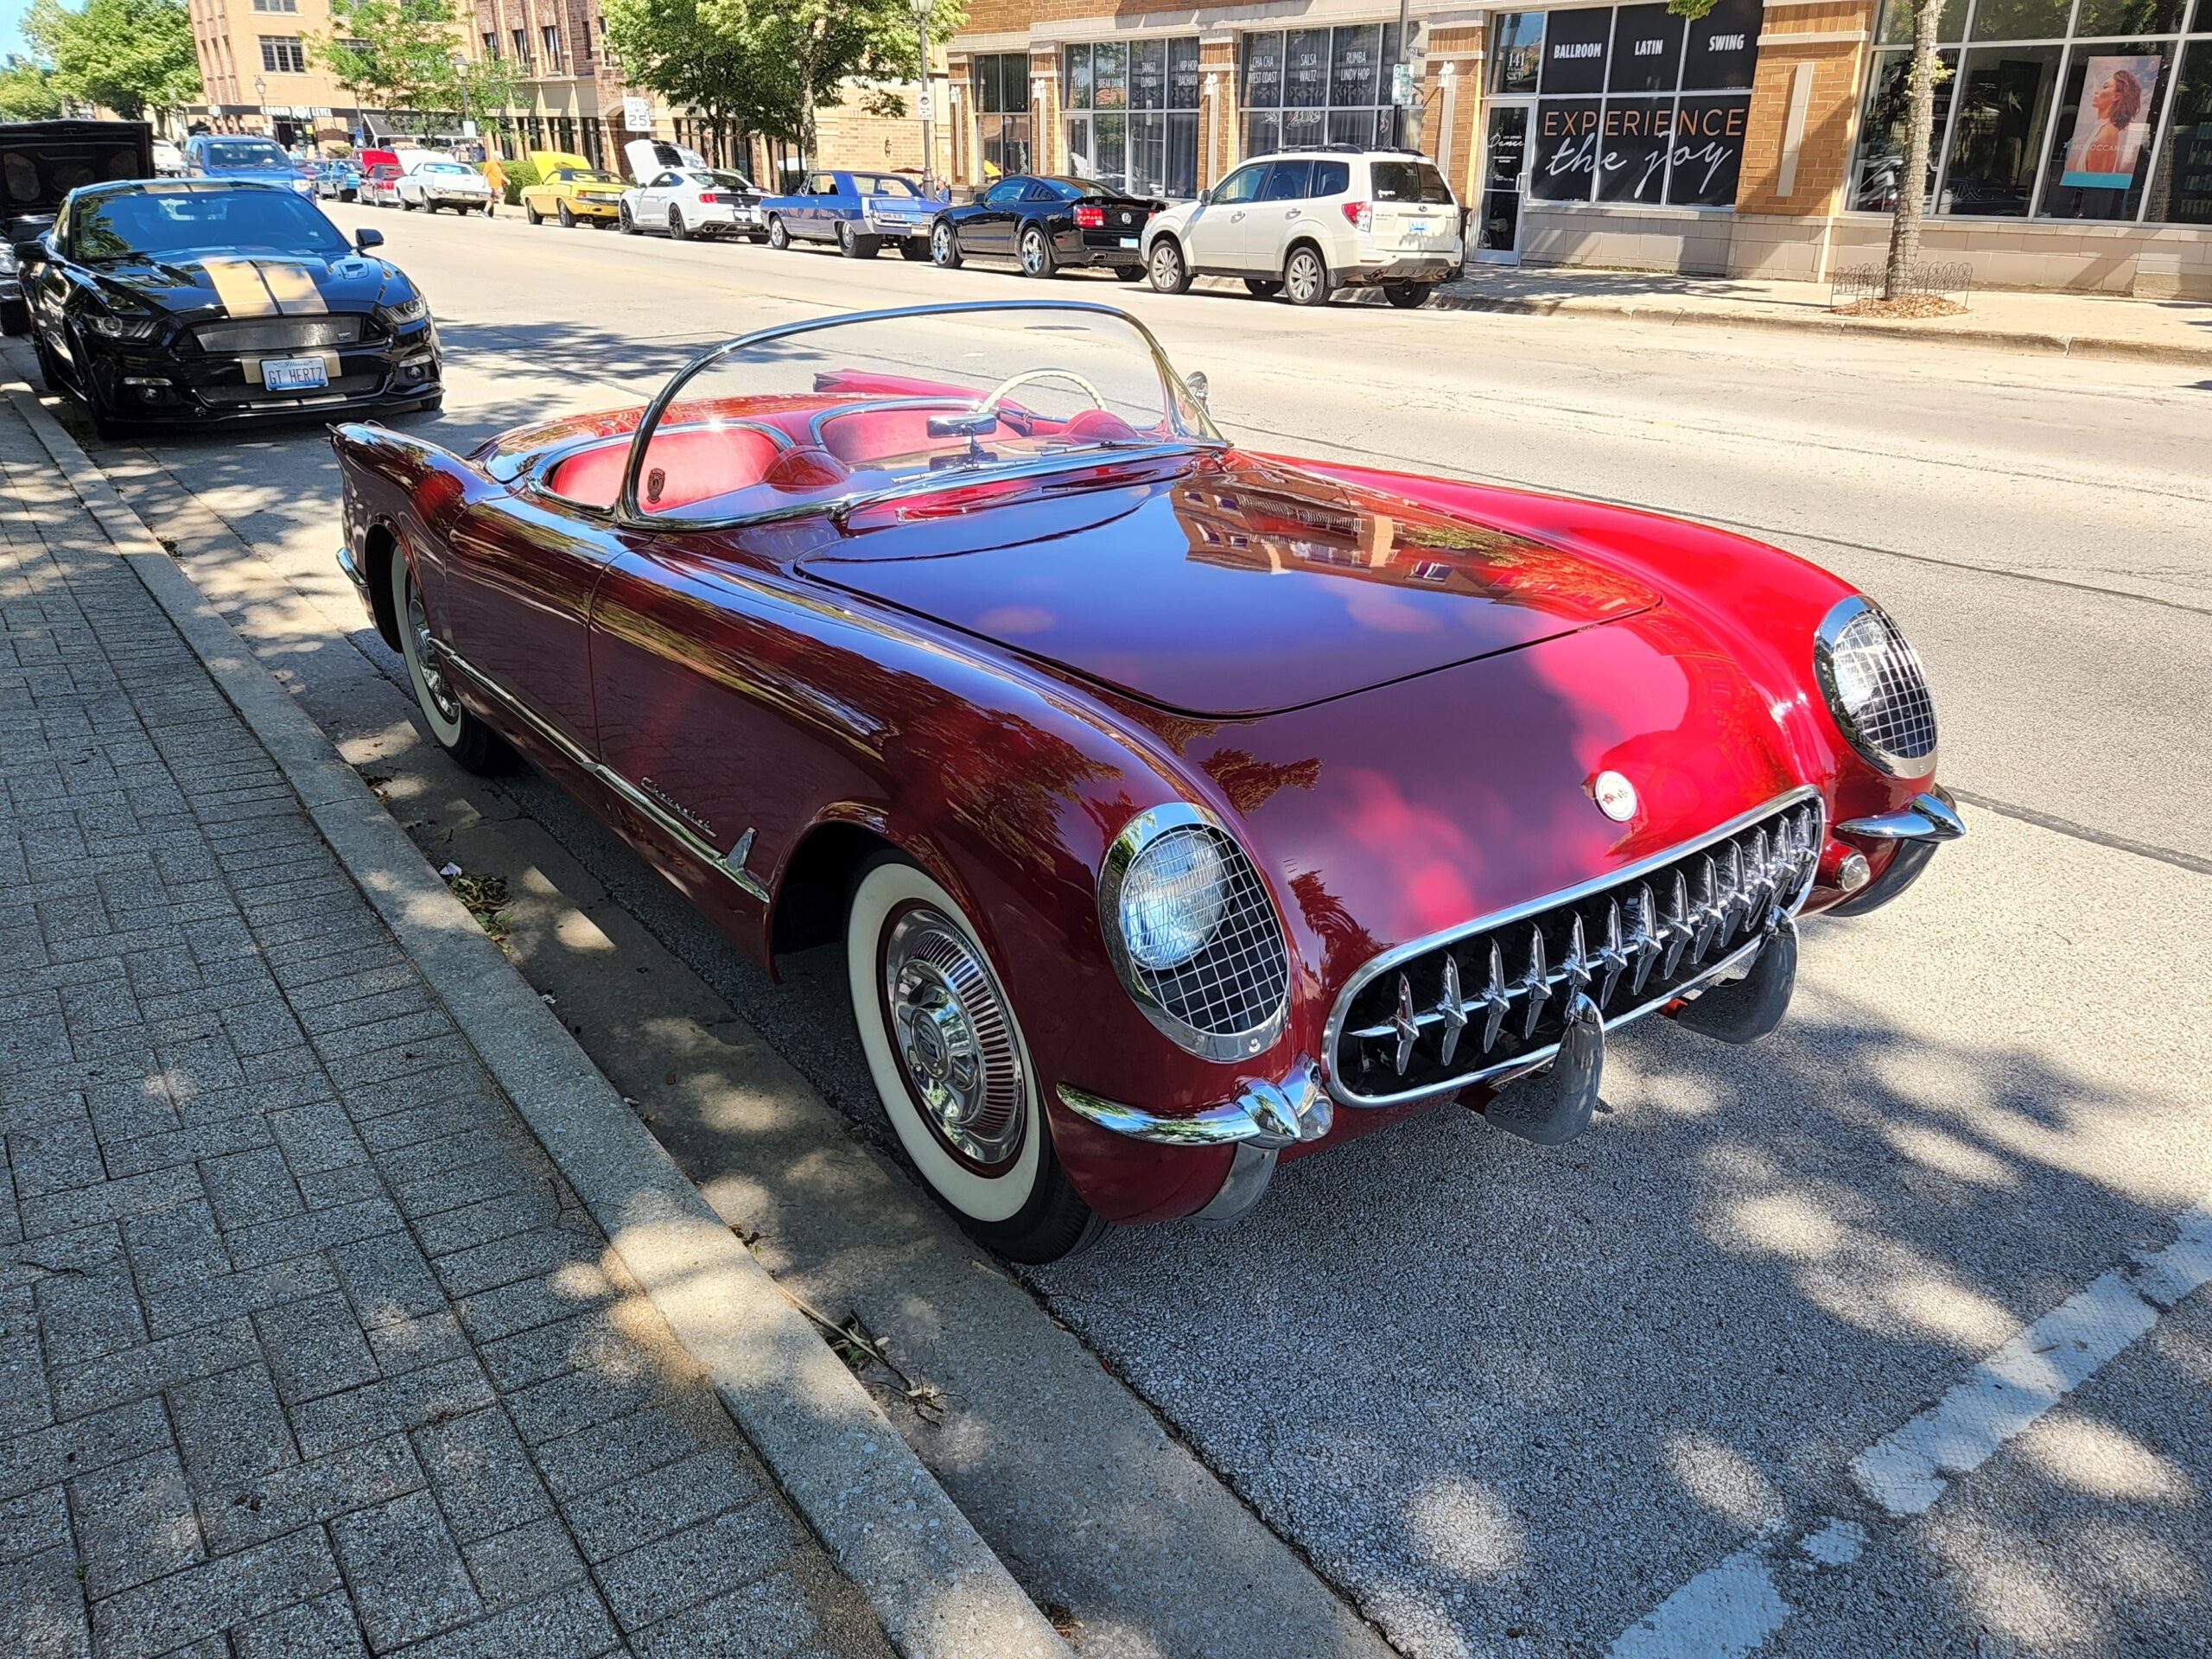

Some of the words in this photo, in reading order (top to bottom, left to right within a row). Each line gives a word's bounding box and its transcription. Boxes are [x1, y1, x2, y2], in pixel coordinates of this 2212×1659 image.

[1634, 39, 1663, 56] LATIN
[1708, 34, 1745, 52] SWING
[1345, 51, 1367, 65] RUMBA
[1554, 43, 1602, 59] BALLROOM
[1179, 60, 1187, 72] HIP
[1187, 60, 1198, 71] HOP
[1252, 55, 1263, 68] CHA
[1263, 54, 1274, 67] CHA
[1300, 54, 1317, 66] SALSA
[1507, 52, 1526, 67] 141
[1141, 61, 1156, 73] TANGO
[1340, 68, 1357, 81] LINDY
[1357, 67, 1370, 80] HOP
[1140, 76, 1157, 88] CUMBIA
[1178, 75, 1198, 86] BACHATA
[1247, 72, 1262, 84] WEST
[1262, 71, 1278, 84] COAST
[1299, 69, 1318, 82] WALTZ
[629, 114, 647, 126] 25
[1543, 108, 1745, 137] EXPERIENCE
[1488, 132, 1525, 149] Dance
[1545, 131, 1627, 176] the
[1634, 130, 1733, 200] joy
[269, 370, 283, 385] GT
[289, 367, 325, 384] HERTZ
